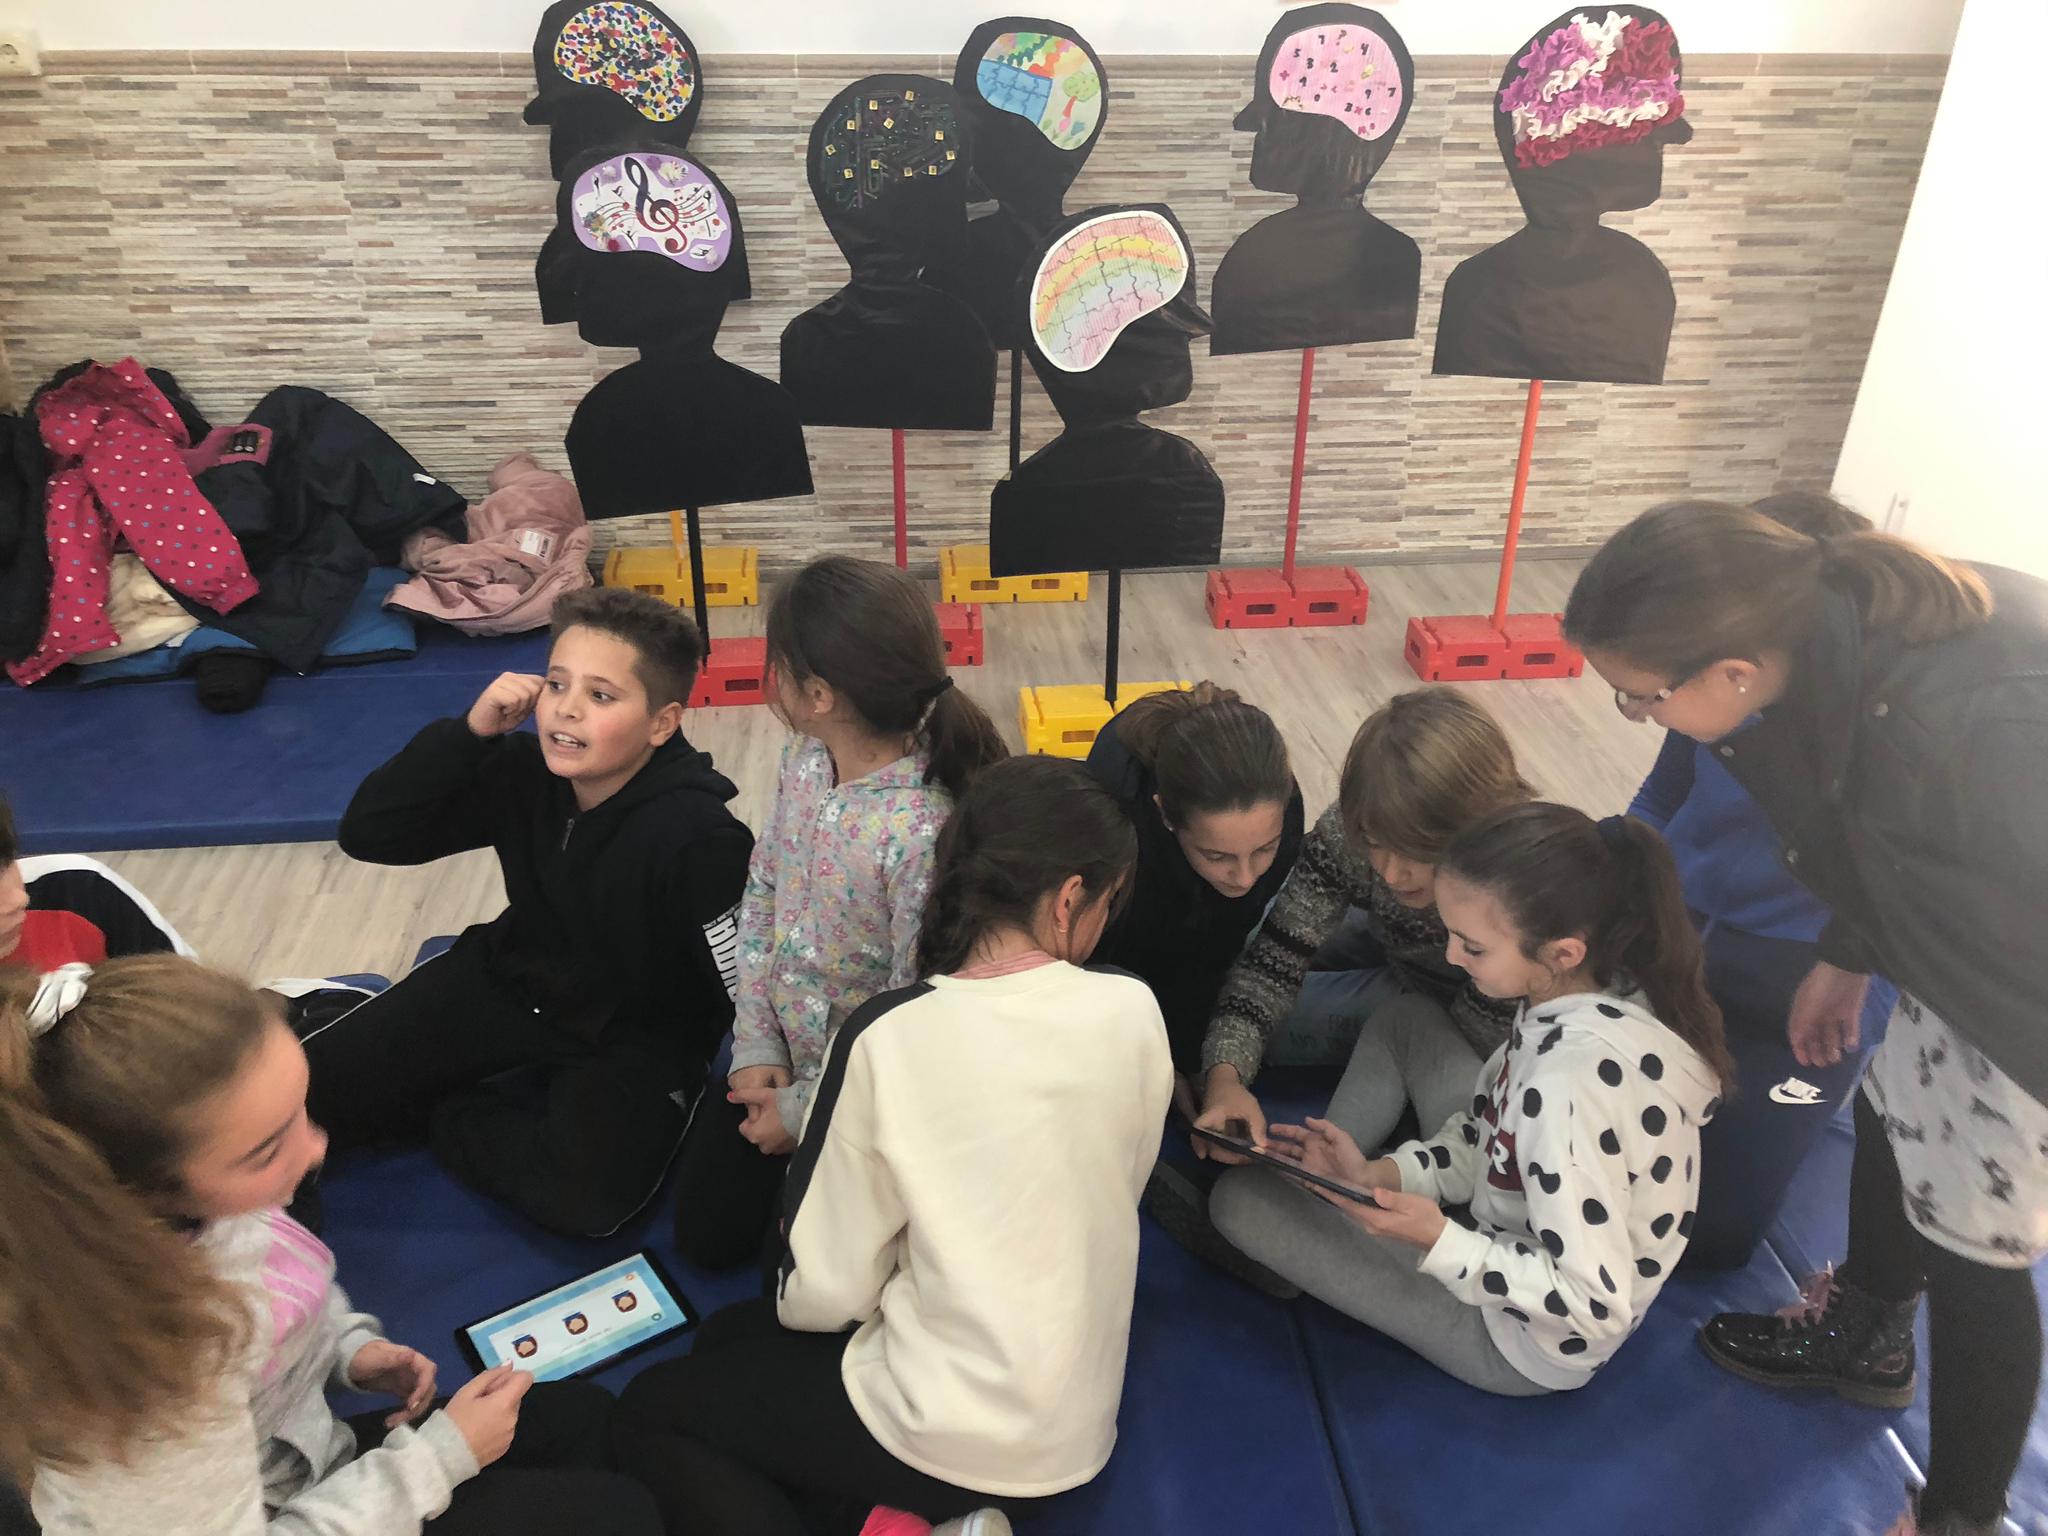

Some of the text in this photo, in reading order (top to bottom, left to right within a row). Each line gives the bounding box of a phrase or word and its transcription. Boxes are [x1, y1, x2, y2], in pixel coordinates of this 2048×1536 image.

[1293, 48, 1301, 58] 5
[1360, 43, 1369, 55] 4
[1330, 62, 1338, 73] 2
[1387, 87, 1397, 97] 7
[1365, 107, 1372, 116] 6
